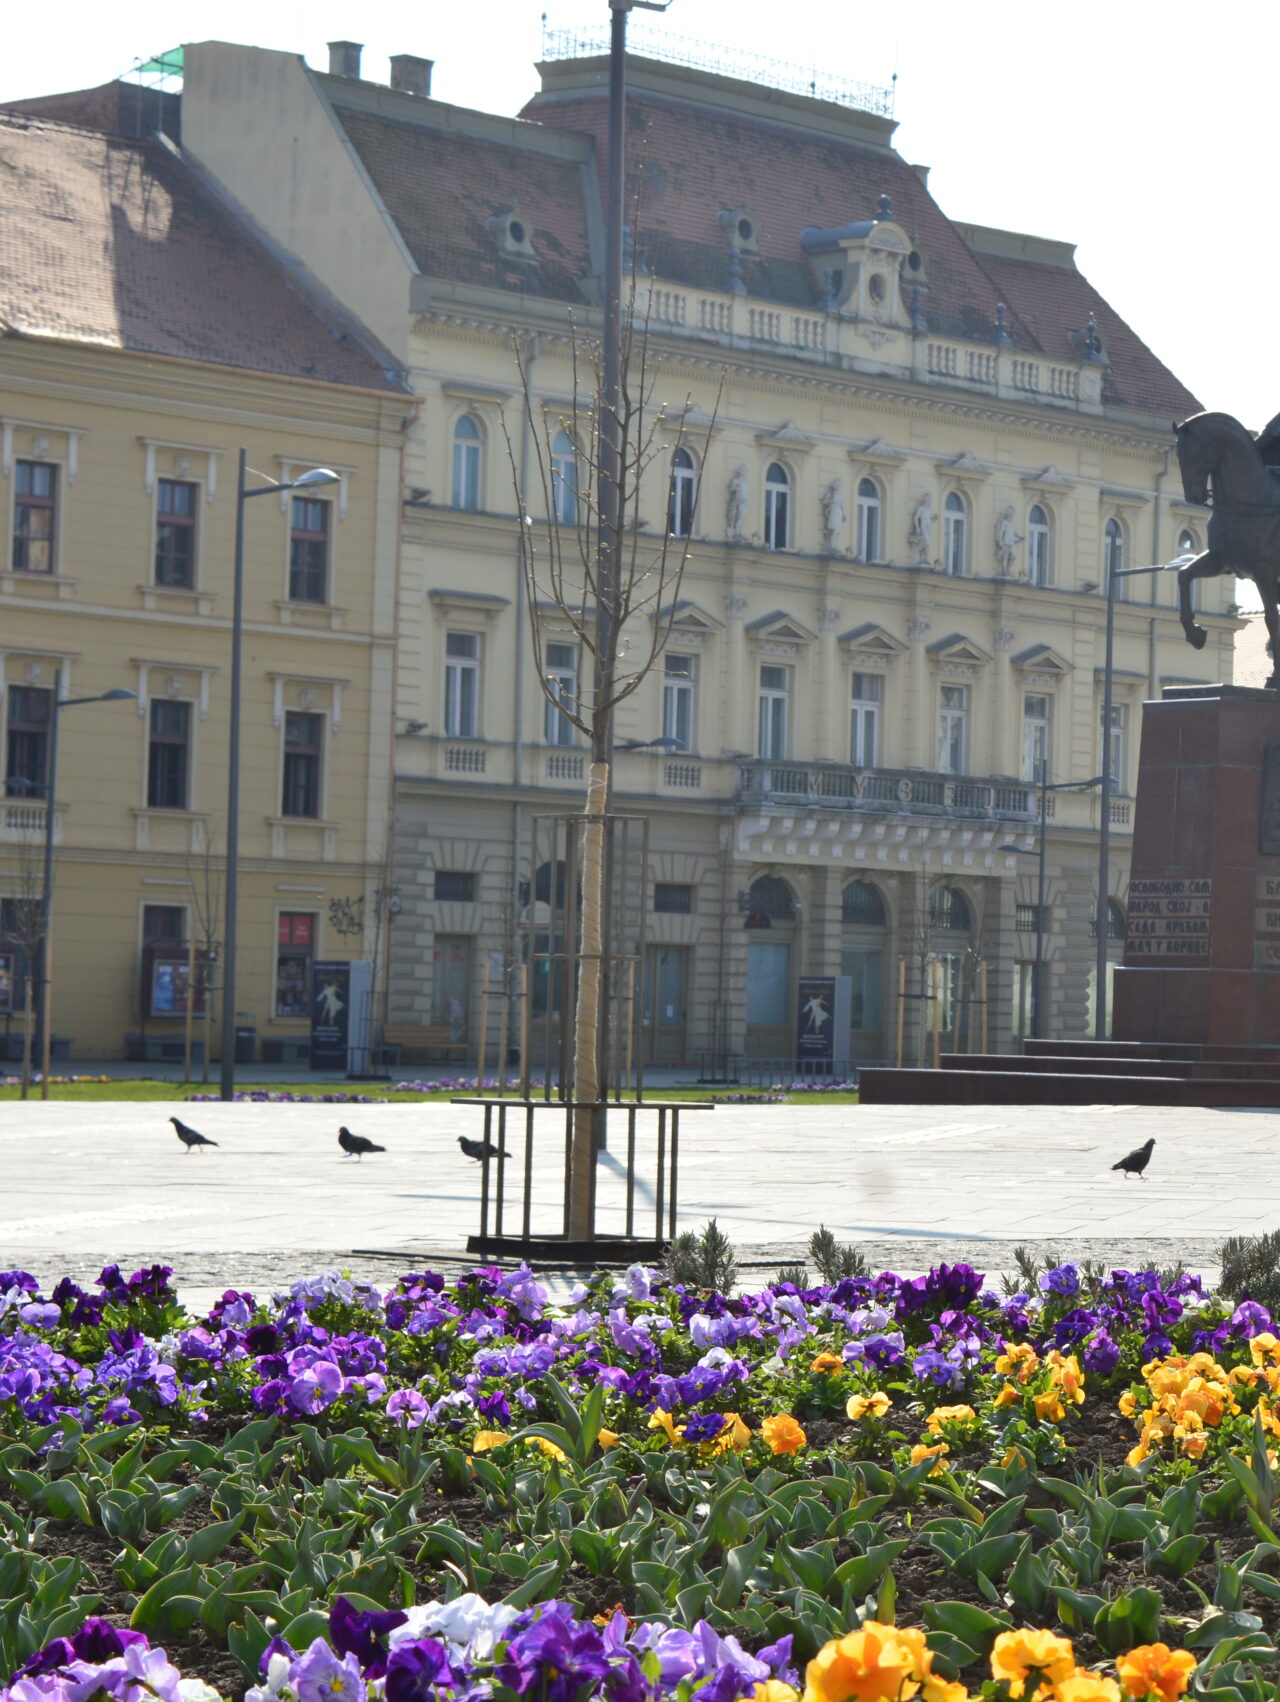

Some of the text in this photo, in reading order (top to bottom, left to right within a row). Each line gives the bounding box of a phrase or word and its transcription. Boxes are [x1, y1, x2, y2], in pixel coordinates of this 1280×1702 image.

[807, 773, 995, 809] МУЗЕЈ
[1189, 881, 1209, 894] САМ
[1266, 946, 1280, 959] СЕ
